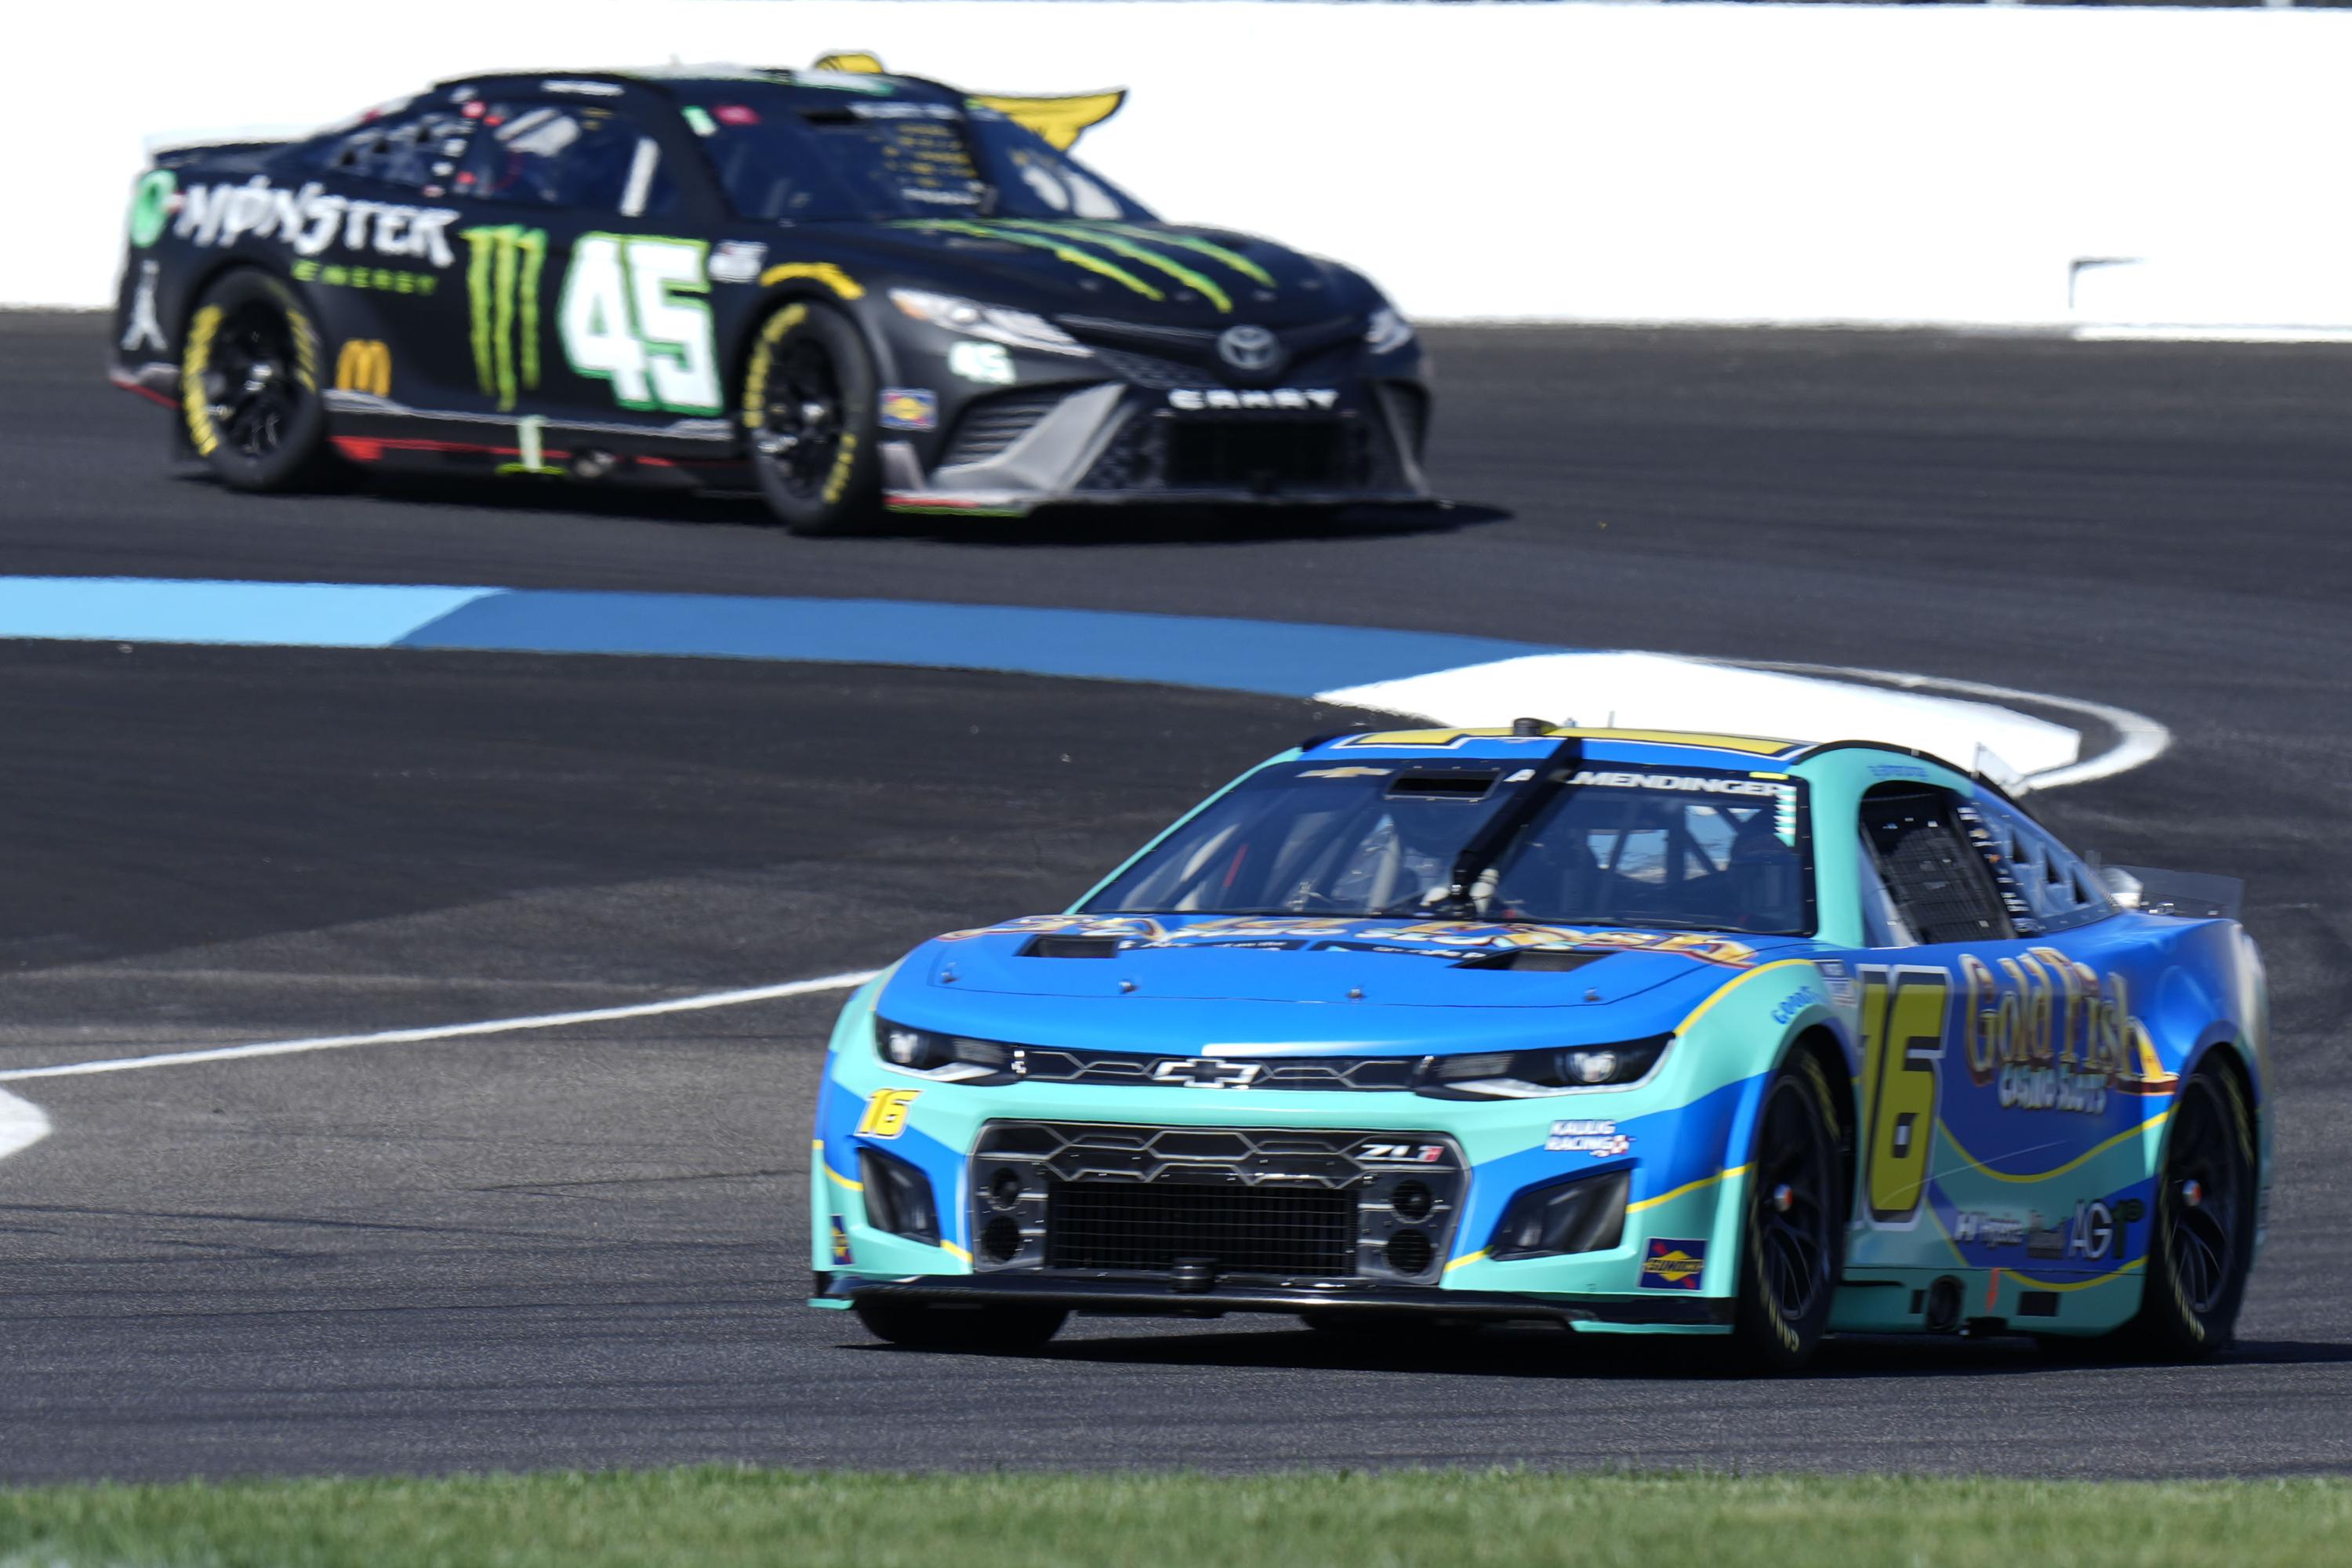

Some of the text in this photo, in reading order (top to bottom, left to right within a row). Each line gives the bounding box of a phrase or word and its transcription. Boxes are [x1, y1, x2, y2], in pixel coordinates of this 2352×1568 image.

[173, 175, 461, 268] MONSTER
[557, 232, 723, 416] 45
[1503, 769, 1791, 797] AMENDINGER
[855, 1088, 924, 1138] 16
[1856, 964, 1954, 1232] 16
